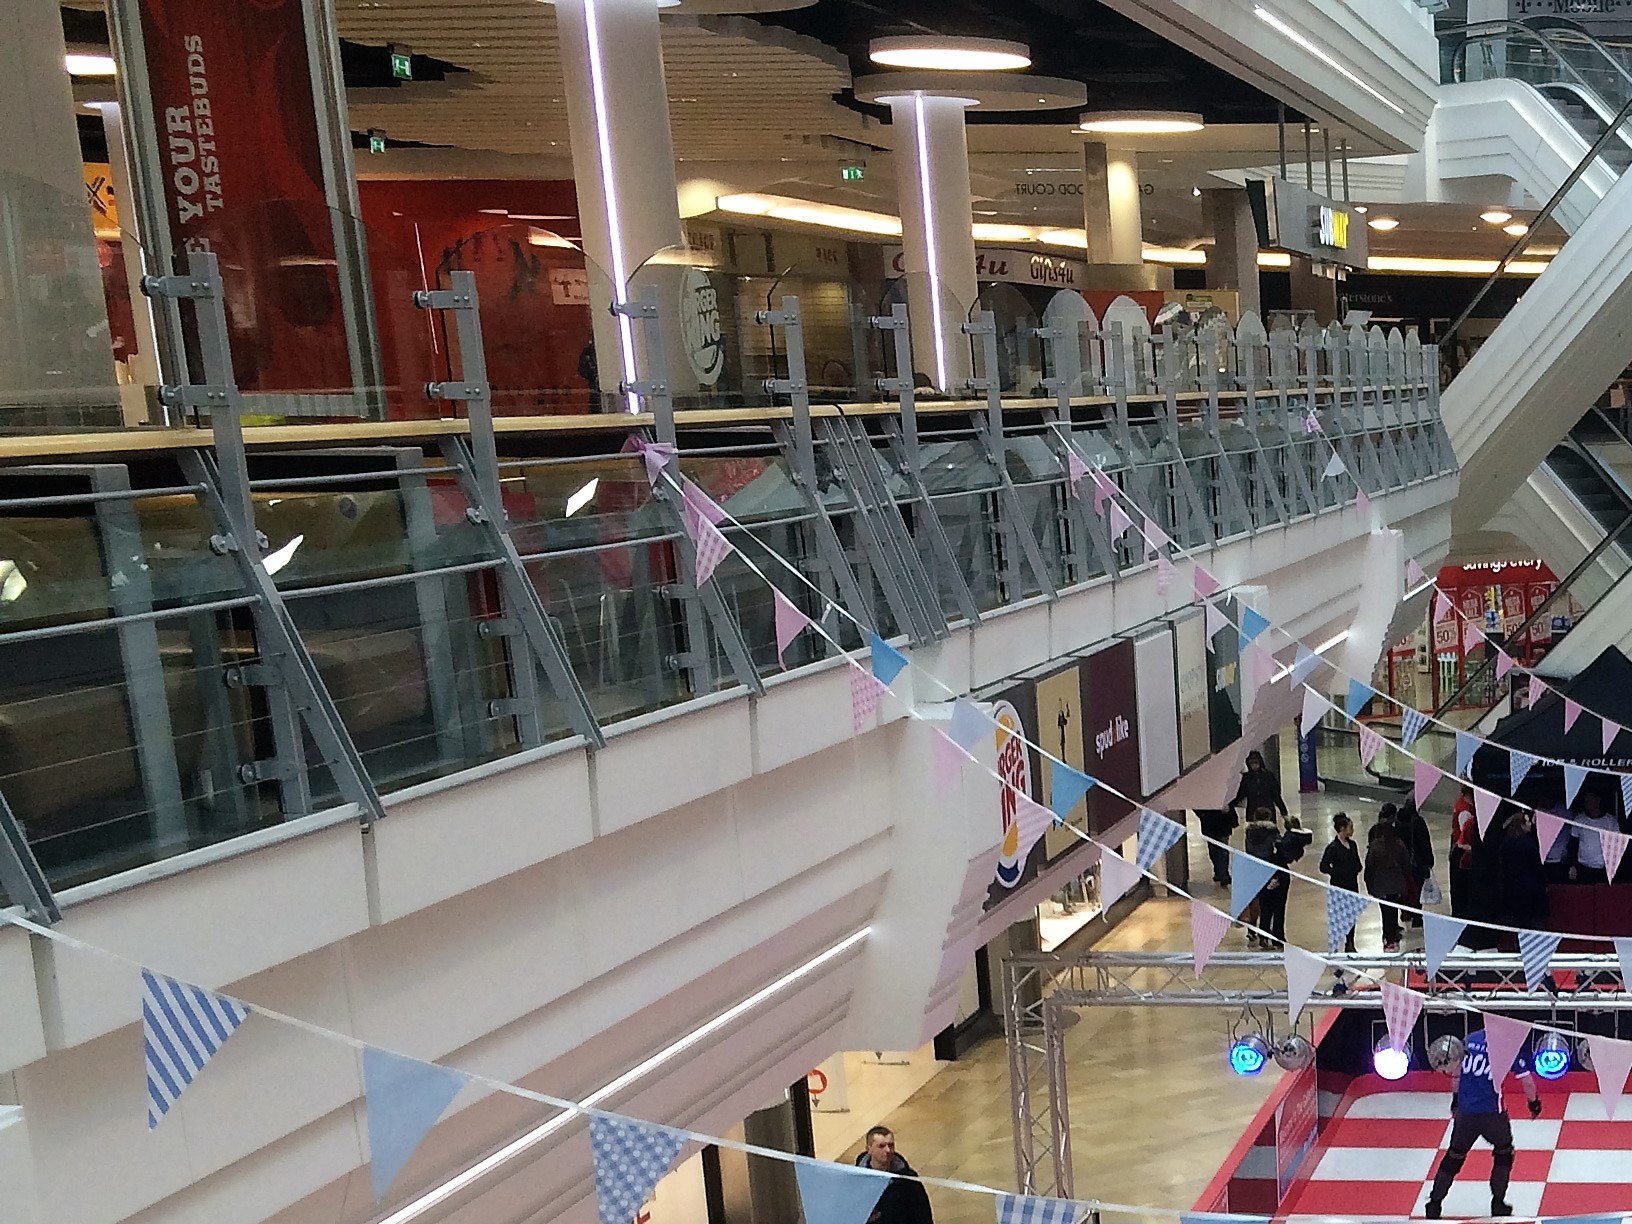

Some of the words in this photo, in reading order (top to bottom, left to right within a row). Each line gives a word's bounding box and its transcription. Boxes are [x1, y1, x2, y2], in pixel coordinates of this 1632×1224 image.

[184, 34, 225, 212] TASTEBUDS
[165, 105, 204, 223] YOUR
[1031, 255, 1075, 284] Gifts4u
[997, 729, 1024, 787] RGER
[1001, 758, 1027, 836] ING
